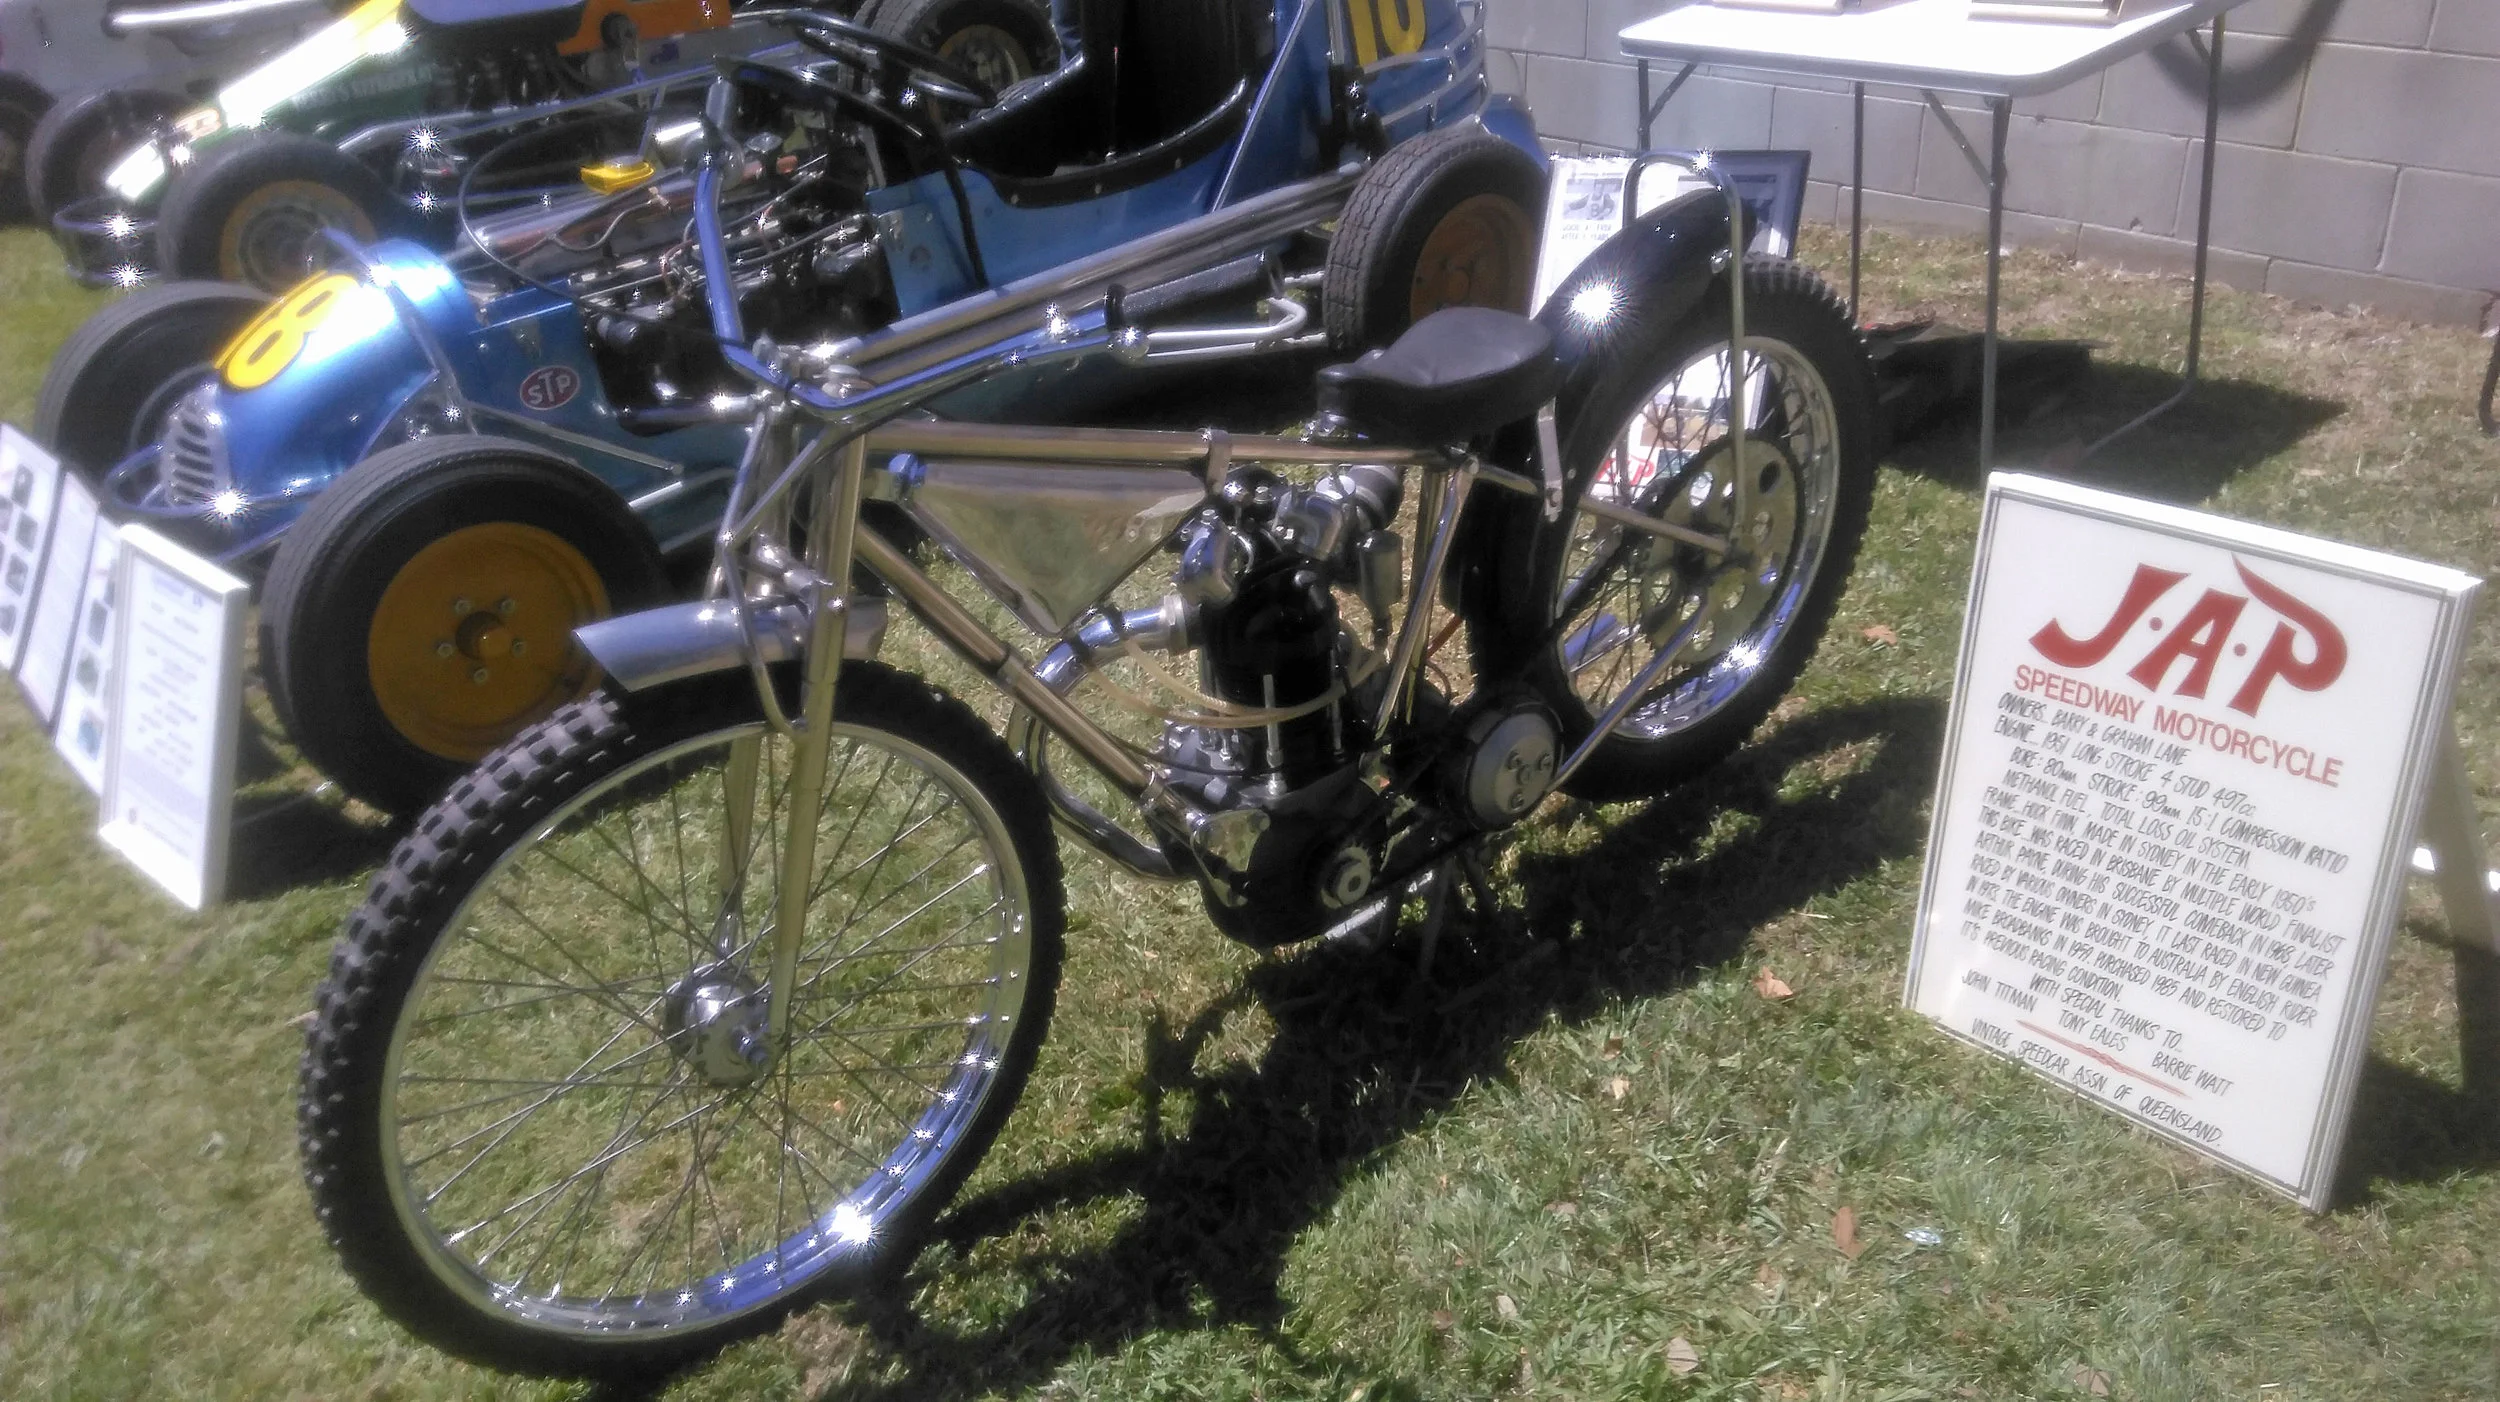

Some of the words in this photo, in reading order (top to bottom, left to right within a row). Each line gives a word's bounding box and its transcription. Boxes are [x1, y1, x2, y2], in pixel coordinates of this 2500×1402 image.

[528, 370, 571, 404] STP
[2013, 664, 2144, 723] SPEEDWAY
[2152, 705, 2343, 788] MOTORCYCLE
[2050, 709, 2090, 733] BARRY
[2086, 722, 2098, 738] &
[2101, 725, 2154, 755] GRAHAM
[2153, 742, 2191, 766] LANE
[2041, 731, 2070, 755] 1951
[2071, 741, 2104, 764] LONG
[2105, 752, 2157, 781] STROKE
[2160, 770, 2174, 787] 4
[2173, 775, 2210, 799] STUD
[2002, 769, 2059, 802] METHANOL
[2100, 801, 2135, 830] TOTAL
[2137, 816, 2174, 841] LOSS
[2174, 828, 2197, 849] OIL
[2219, 816, 2306, 859] COMPRESSION
[2303, 845, 2348, 873] RATIO
[1978, 805, 2000, 828] THIS
[2027, 825, 2054, 848] WAS
[2053, 835, 2089, 860] RACED
[2089, 847, 2107, 867] IN
[2105, 854, 2162, 887] BRISBANE
[2161, 874, 2182, 894] BY
[2179, 881, 2240, 916] MULTIPLE
[2238, 902, 2281, 931] WORLD
[2282, 919, 2346, 955] FINALIST
[2080, 821, 2119, 847] MADE
[2118, 834, 2137, 854] IN
[2137, 841, 2186, 870] SYDNEY
[2182, 856, 2202, 876] IN
[2200, 861, 2232, 886] THE
[2228, 873, 2273, 902] EARLY
[1970, 853, 2001, 877] RACED
[2000, 864, 2017, 882] BY
[2015, 869, 2055, 898] VARIOUS
[2055, 886, 2097, 914] OWNERS
[2096, 902, 2113, 920] IN
[2155, 924, 2173, 942] IT
[2170, 930, 2204, 954] LAST
[2200, 942, 2237, 968] RACED
[2235, 956, 2253, 976] IN
[2250, 962, 2283, 986] NEW
[2278, 973, 2322, 1001] GUINEA
[1974, 830, 2014, 859] ARTHUR
[2050, 858, 2089, 886] DURING
[2086, 871, 2110, 893] HIS
[2111, 881, 2180, 921] SUCCESSFUL
[2183, 909, 2252, 948] COMEBACK
[2248, 933, 2269, 954] IN
[2293, 951, 2334, 979] LATER
[1963, 898, 1992, 920] MIKE
[2052, 934, 2069, 952] IN
[2093, 950, 2151, 985] PURCHASED
[2150, 974, 2181, 997] 1985
[2178, 986, 2207, 1008] AND
[2204, 996, 2266, 1032] RESTORED
[2267, 1021, 2286, 1040] TO
[1965, 875, 1980, 892] IN
[2001, 889, 2024, 909] THE
[2021, 896, 2061, 924] ENGINE
[2059, 911, 2084, 933] WAS
[2083, 921, 2134, 952] BROUGHT
[2133, 940, 2150, 960] TO
[2146, 947, 2208, 984] AUSTRALIA
[2207, 970, 2230, 991] BY
[2226, 978, 2279, 1013] ENGLISH
[2279, 1000, 2317, 1028] RIDER
[1983, 930, 2030, 961] PREVIOUS
[2028, 948, 2067, 976] RACING
[2067, 965, 2124, 1002] CONDITION.
[1962, 969, 1991, 992] JOHN
[1995, 981, 2038, 1013] TITMAN
[2029, 972, 2061, 998] WITH
[2060, 987, 2106, 1018] SPECIAL
[2110, 1007, 2160, 1040] THANKS
[2058, 1009, 2091, 1034] TONY
[2089, 1024, 2128, 1052] EALES
[1971, 1018, 2013, 1048] VINTAGE
[2013, 1040, 2069, 1076] SPEEDCAR
[2113, 1084, 2133, 1101] OF
[2138, 1095, 2223, 1146] QUEENSLAND.
[2151, 1051, 2197, 1081] BARRIE
[2194, 1069, 2234, 1096] WATT
